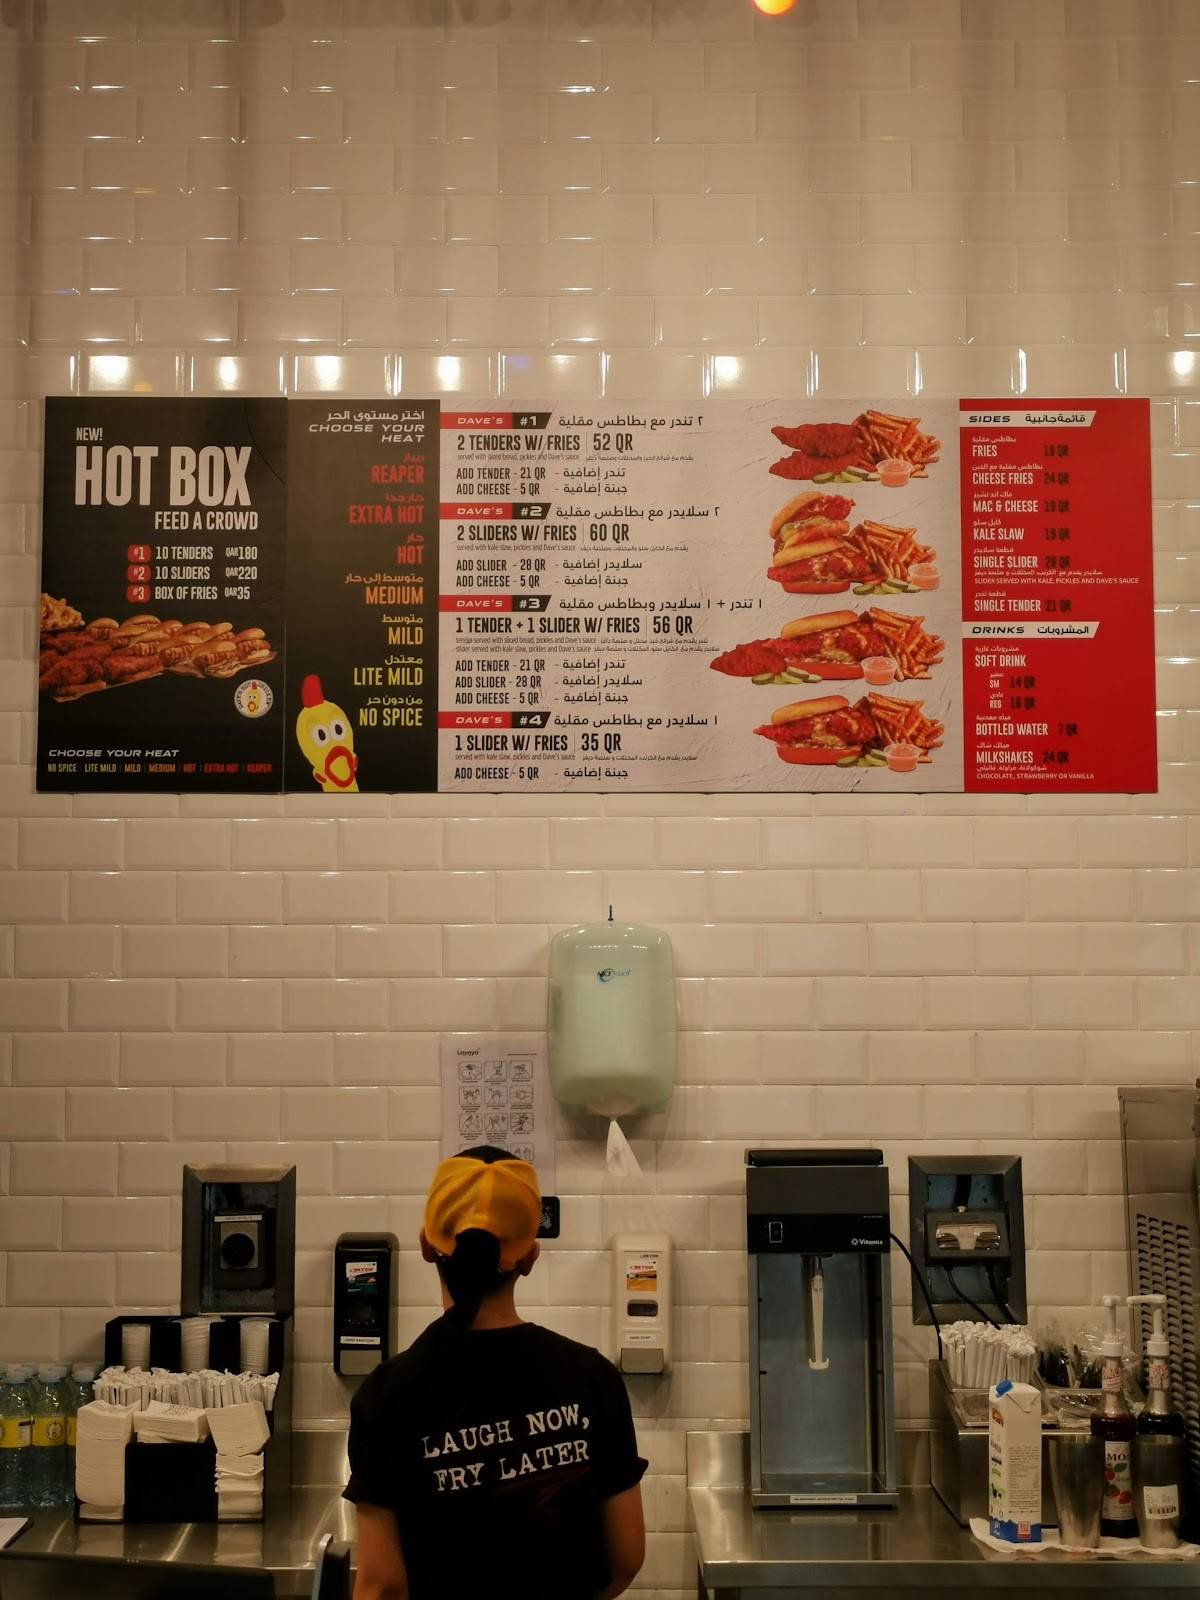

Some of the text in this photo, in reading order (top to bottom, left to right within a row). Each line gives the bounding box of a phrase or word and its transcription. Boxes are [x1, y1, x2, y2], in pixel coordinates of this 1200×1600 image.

[327, 410, 424, 422] اختر مستوى الحر
[458, 416, 537, 426] DAVE'S #1
[1025, 414, 1086, 424] قائمة جانبية
[309, 424, 425, 432] CHOOSE YOUR
[559, 415, 703, 430] ٢ تندر مع بطاطس مقلية
[76, 427, 103, 441] NEW!
[457, 433, 633, 452] 2 TENDERS W/ FRIES 52 QR
[972, 445, 997, 457] FRIES
[74, 446, 252, 506] HOT BOX
[371, 465, 424, 484] REAPER
[457, 467, 546, 480] ADD TENDER 21 QR
[973, 473, 1033, 485] CHEESE FRIES
[457, 483, 540, 495] ADD CHEESE 5 QR
[457, 506, 542, 516] DAVE'S #2
[973, 500, 1038, 512] MAC & CHEESE
[154, 511, 258, 530] FEED A CROWD
[349, 505, 424, 524] EXTRA HOT
[457, 524, 629, 543] 2 SLIDERS W/ FRIES 60 QR
[974, 528, 1024, 540] KALE SLAW
[134, 546, 144, 560] #1
[156, 546, 168, 560] 10
[171, 546, 213, 560] TENDERS
[398, 546, 424, 564] HOT
[456, 559, 546, 571] ADD SLIDER 28 QR
[974, 556, 1038, 568] SINGLE SLIDER
[133, 566, 144, 580] #2
[155, 566, 168, 580] 10
[171, 566, 210, 580] SLIDERS
[344, 574, 362, 584] حار
[383, 574, 424, 583] متوسط
[456, 575, 540, 587] ADD CHEESE 5 QR
[133, 586, 144, 600] #3
[155, 586, 174, 600] BOX
[176, 586, 188, 600] OF
[191, 586, 217, 600] FRIES
[366, 586, 423, 604] MEDIUM
[456, 598, 540, 609] DAVE'S #3
[974, 600, 1041, 612] SINGLE TENDER
[382, 614, 423, 624] متوسط
[456, 618, 463, 633] 1
[468, 618, 512, 633] TENDER
[528, 618, 535, 633] 1
[539, 618, 580, 633] SLIDER
[584, 618, 602, 633] W/
[607, 618, 640, 633] FRIES
[653, 616, 670, 633] 56
[676, 616, 693, 636] QR
[1037, 625, 1089, 635] المشروبات
[388, 627, 423, 645] MILD
[385, 655, 423, 665] معتدل
[975, 655, 1026, 667] SOFT DRINK
[354, 668, 423, 685] LITE MILD
[990, 680, 1000, 688] SM
[367, 695, 423, 705] من دون حر
[990, 700, 1002, 708] REG
[360, 708, 423, 726] NO SPICE
[455, 715, 542, 726] DAVE'S #4
[976, 723, 1048, 735] BOTTLED WATER
[455, 733, 621, 752] 1 SLIDER W/ FRIES 35 QR
[976, 751, 1033, 764] MILKSHAKES
[48, 764, 176, 772] NO SPICE LITE MILD MILD MEDIUM
[422, 1404, 590, 1458] LAUGH NOW,
[433, 1440, 590, 1492] FRY LATER
